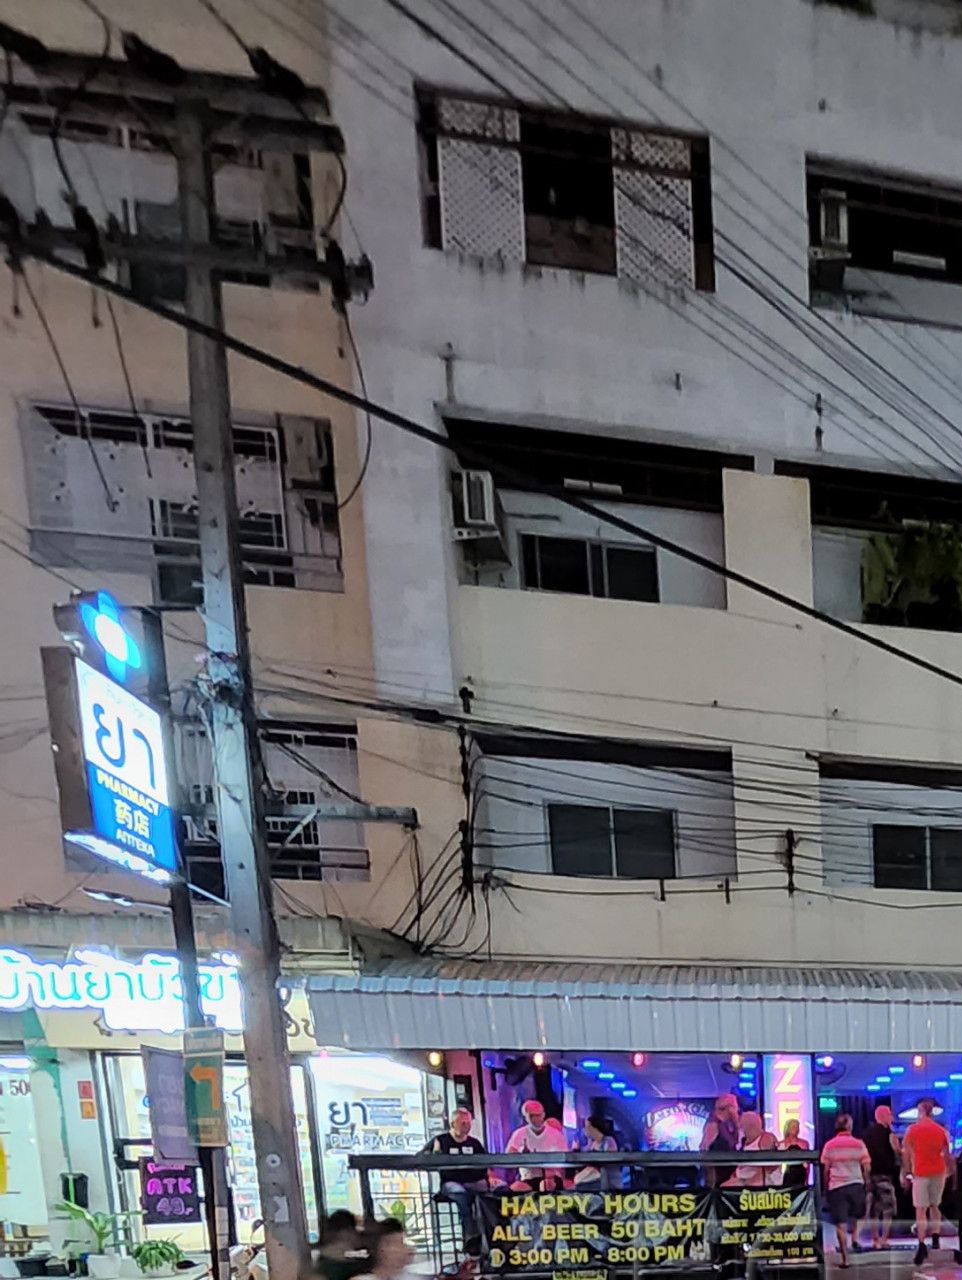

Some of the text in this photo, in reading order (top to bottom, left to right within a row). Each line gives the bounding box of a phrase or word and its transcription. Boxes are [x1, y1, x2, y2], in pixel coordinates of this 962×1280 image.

[93, 703, 156, 790] ยา
[96, 768, 159, 816] PHARMACY
[328, 1101, 368, 1126] ยา
[330, 1134, 412, 1147] PHARMACY
[147, 1178, 193, 1195] ATK
[501, 1193, 696, 1216] HAPPY HOURS
[492, 1225, 532, 1242] ALL
[542, 1224, 600, 1241] BEER
[611, 1220, 639, 1239] 50
[645, 1218, 706, 1238] BAHT
[509, 1248, 552, 1265] 3:00
[556, 1248, 588, 1264] PM
[607, 1247, 649, 1263] 8:00
[654, 1245, 684, 1262] PM
